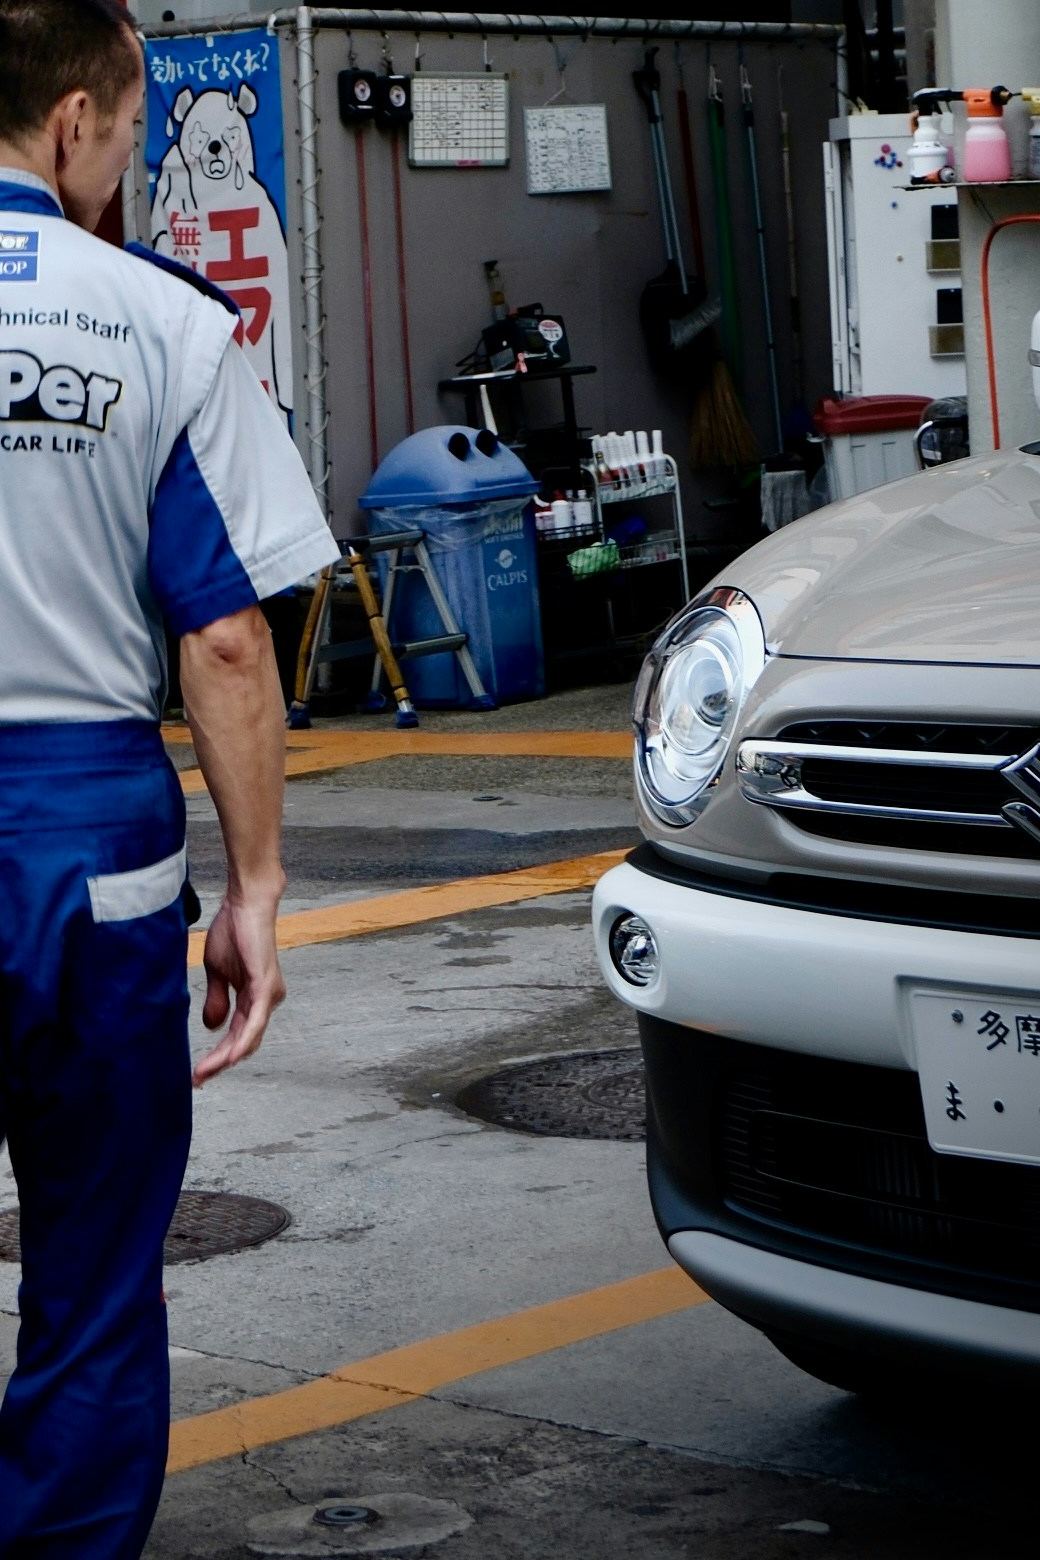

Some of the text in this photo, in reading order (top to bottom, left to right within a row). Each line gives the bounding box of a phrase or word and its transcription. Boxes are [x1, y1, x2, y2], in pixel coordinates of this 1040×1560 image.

[76, 313, 131, 342] Staff
[0, 435, 42, 452] CAR
[52, 438, 96, 458] LIFE
[487, 569, 528, 591] CALPIS
[945, 1080, 967, 1121] ま
